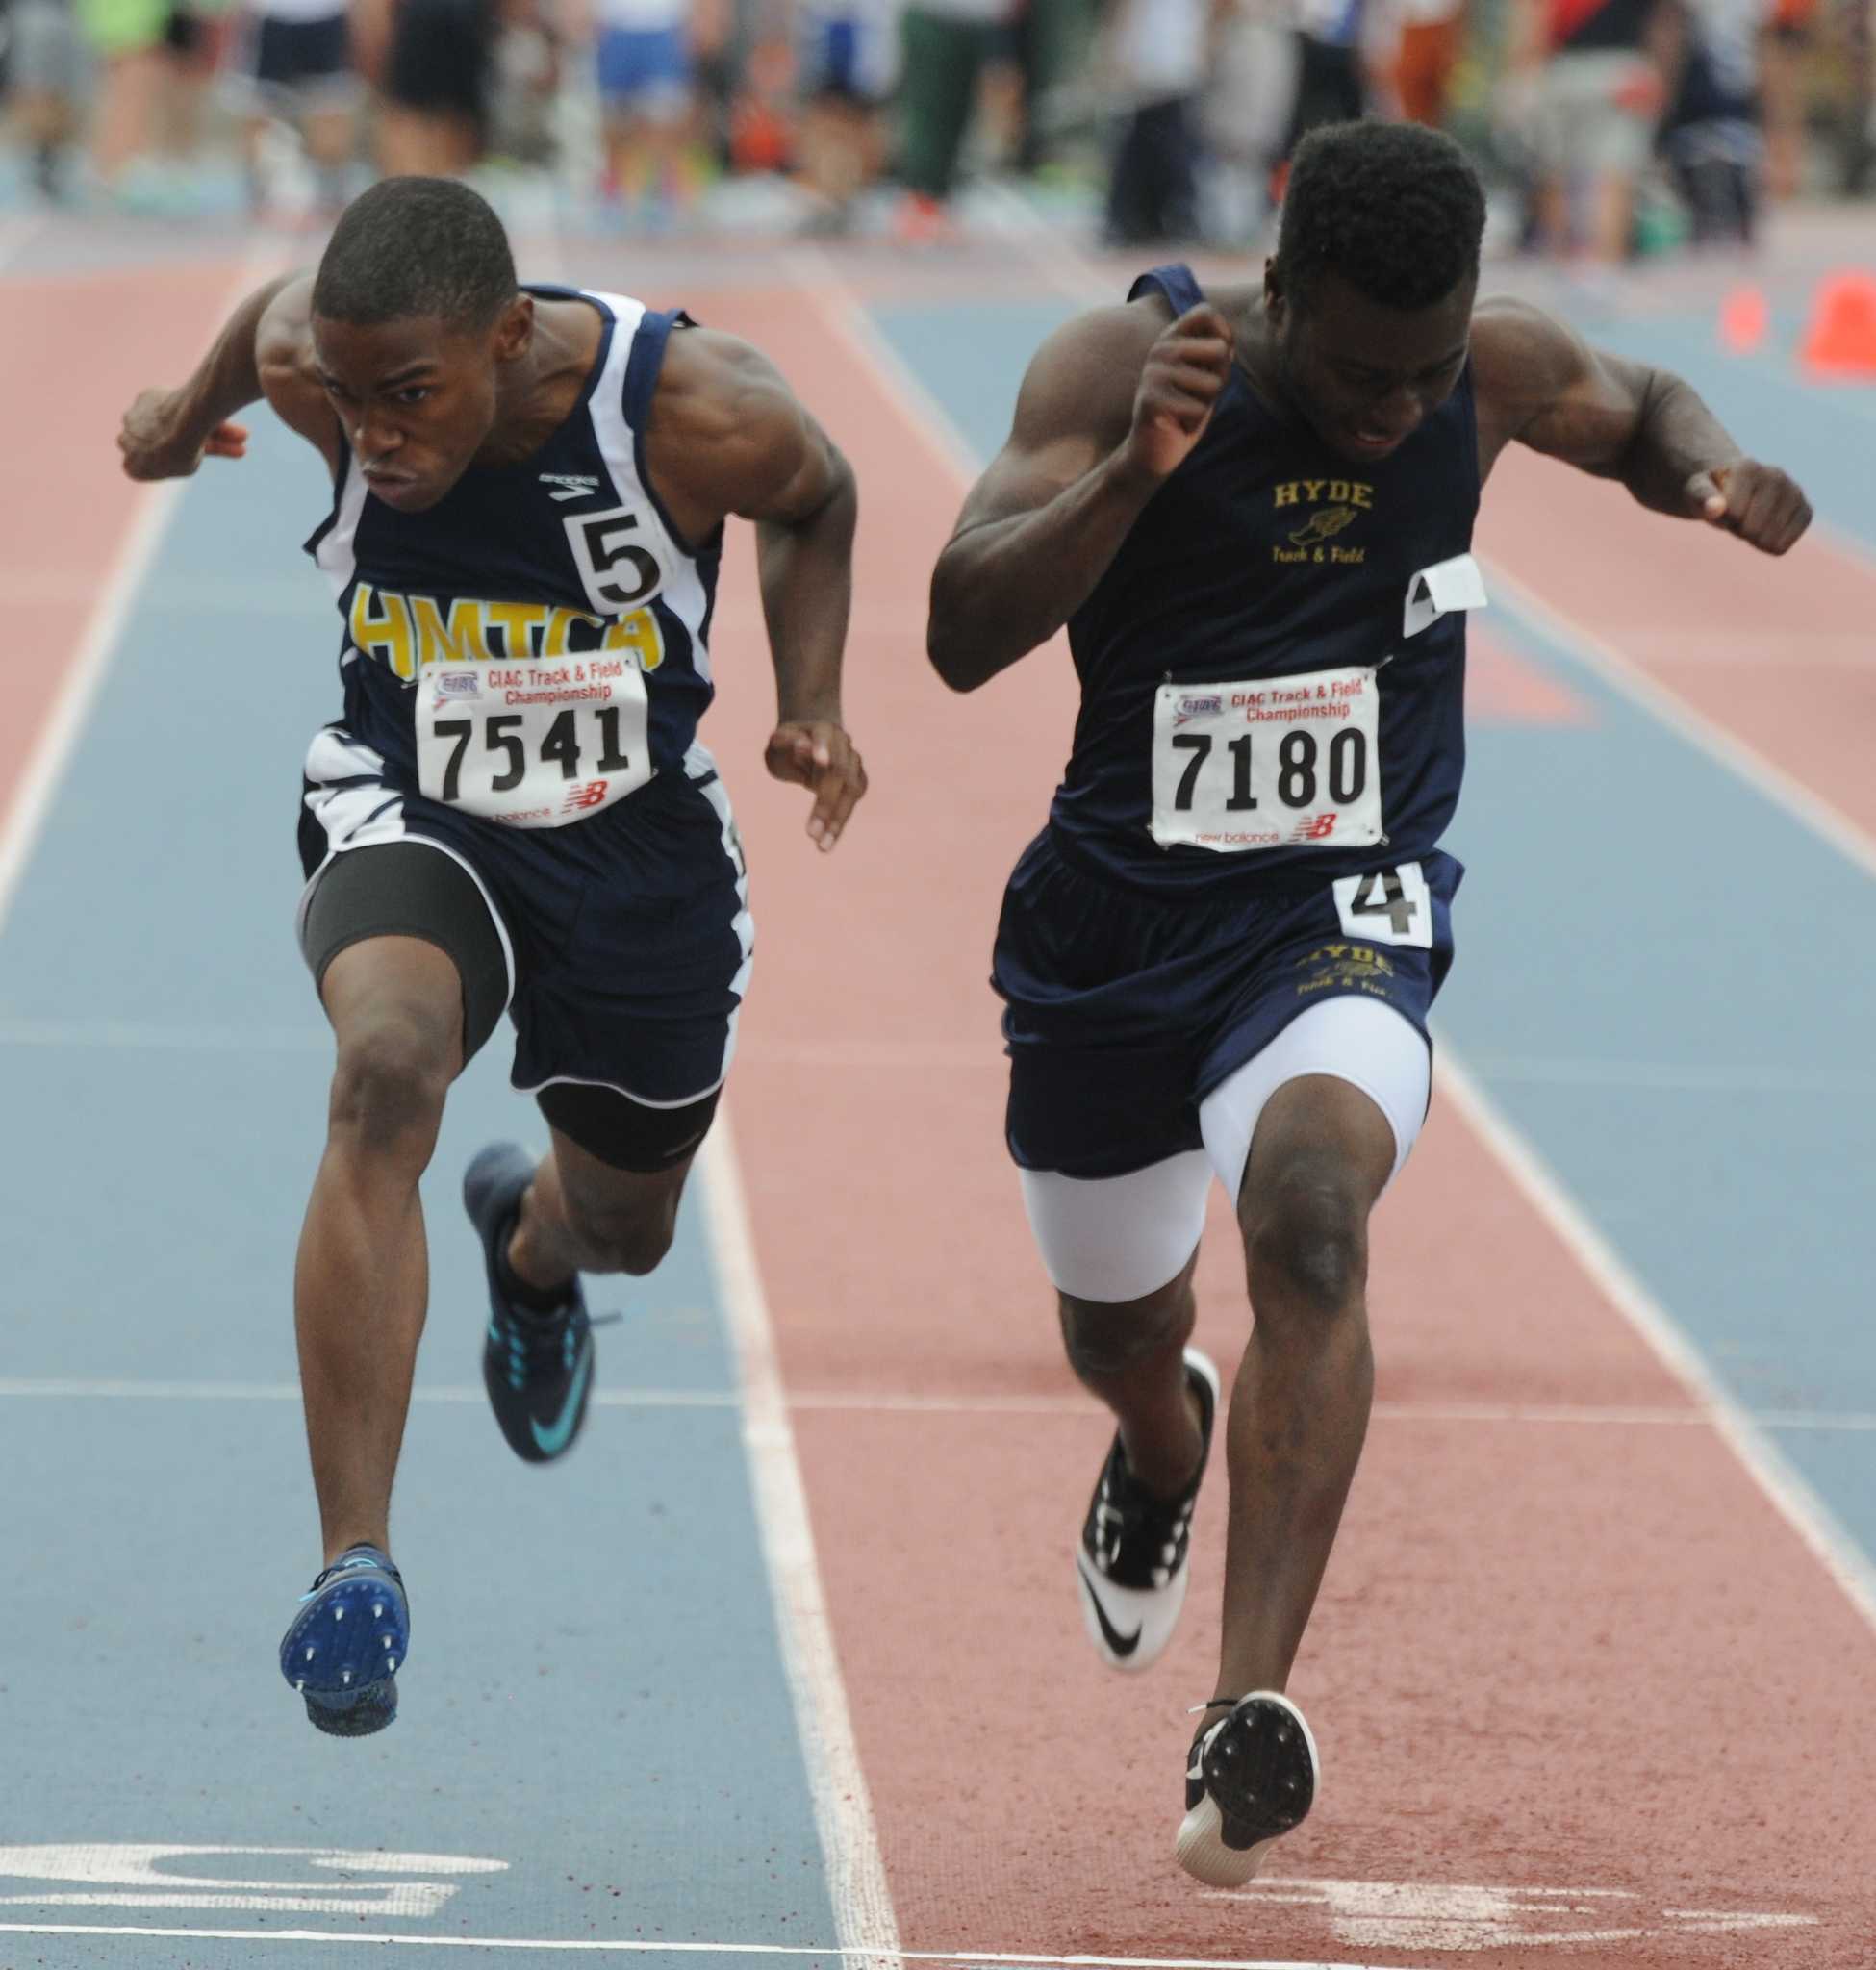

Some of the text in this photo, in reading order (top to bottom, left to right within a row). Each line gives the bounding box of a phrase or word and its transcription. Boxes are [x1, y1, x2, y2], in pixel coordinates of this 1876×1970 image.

[1274, 480, 1373, 508] HYDE
[582, 514, 662, 604] 5
[1313, 546, 1325, 563] &
[349, 580, 666, 684] HMTCA
[488, 661, 623, 688] CIAC Track & Field
[505, 684, 612, 706] Championship
[1231, 677, 1363, 708] CIAC Track & Field
[1246, 703, 1351, 722] Championship
[433, 706, 629, 802] 7541
[1172, 727, 1367, 811] 7180
[1224, 831, 1279, 845] balance
[1351, 871, 1418, 935] 4
